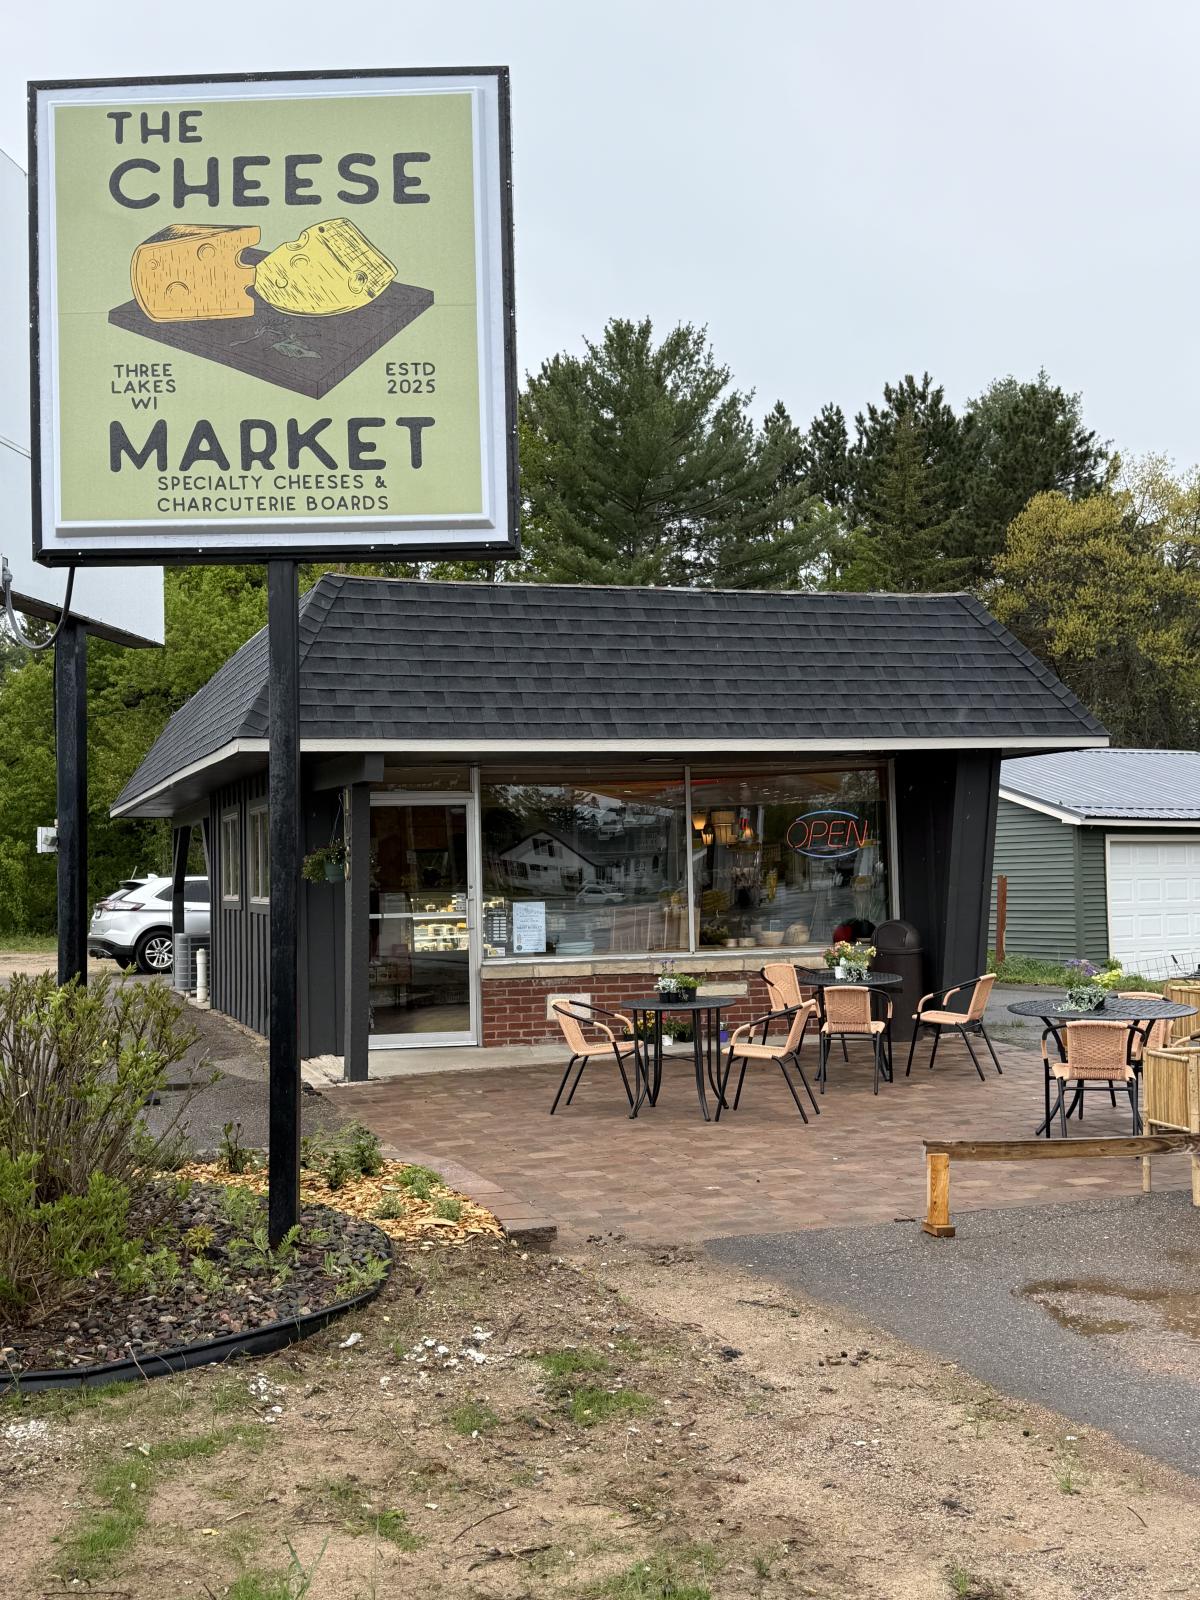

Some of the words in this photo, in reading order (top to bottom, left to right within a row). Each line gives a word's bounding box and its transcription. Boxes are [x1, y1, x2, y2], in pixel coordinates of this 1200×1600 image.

[106, 111, 203, 145] THE
[108, 152, 431, 210] CHEESE
[113, 363, 173, 378] THREE
[385, 362, 436, 377] ESTD
[111, 379, 177, 394] LAKES
[387, 378, 436, 394] 2025
[131, 396, 158, 411] WI
[109, 416, 436, 473] MARKET
[158, 475, 263, 491] SPECIALTY
[273, 474, 364, 490] CHEESES
[375, 475, 388, 489] &
[157, 496, 296, 512] CHARCUTERIE
[306, 495, 389, 511] BOARDS
[786, 819, 868, 849] OPEN
